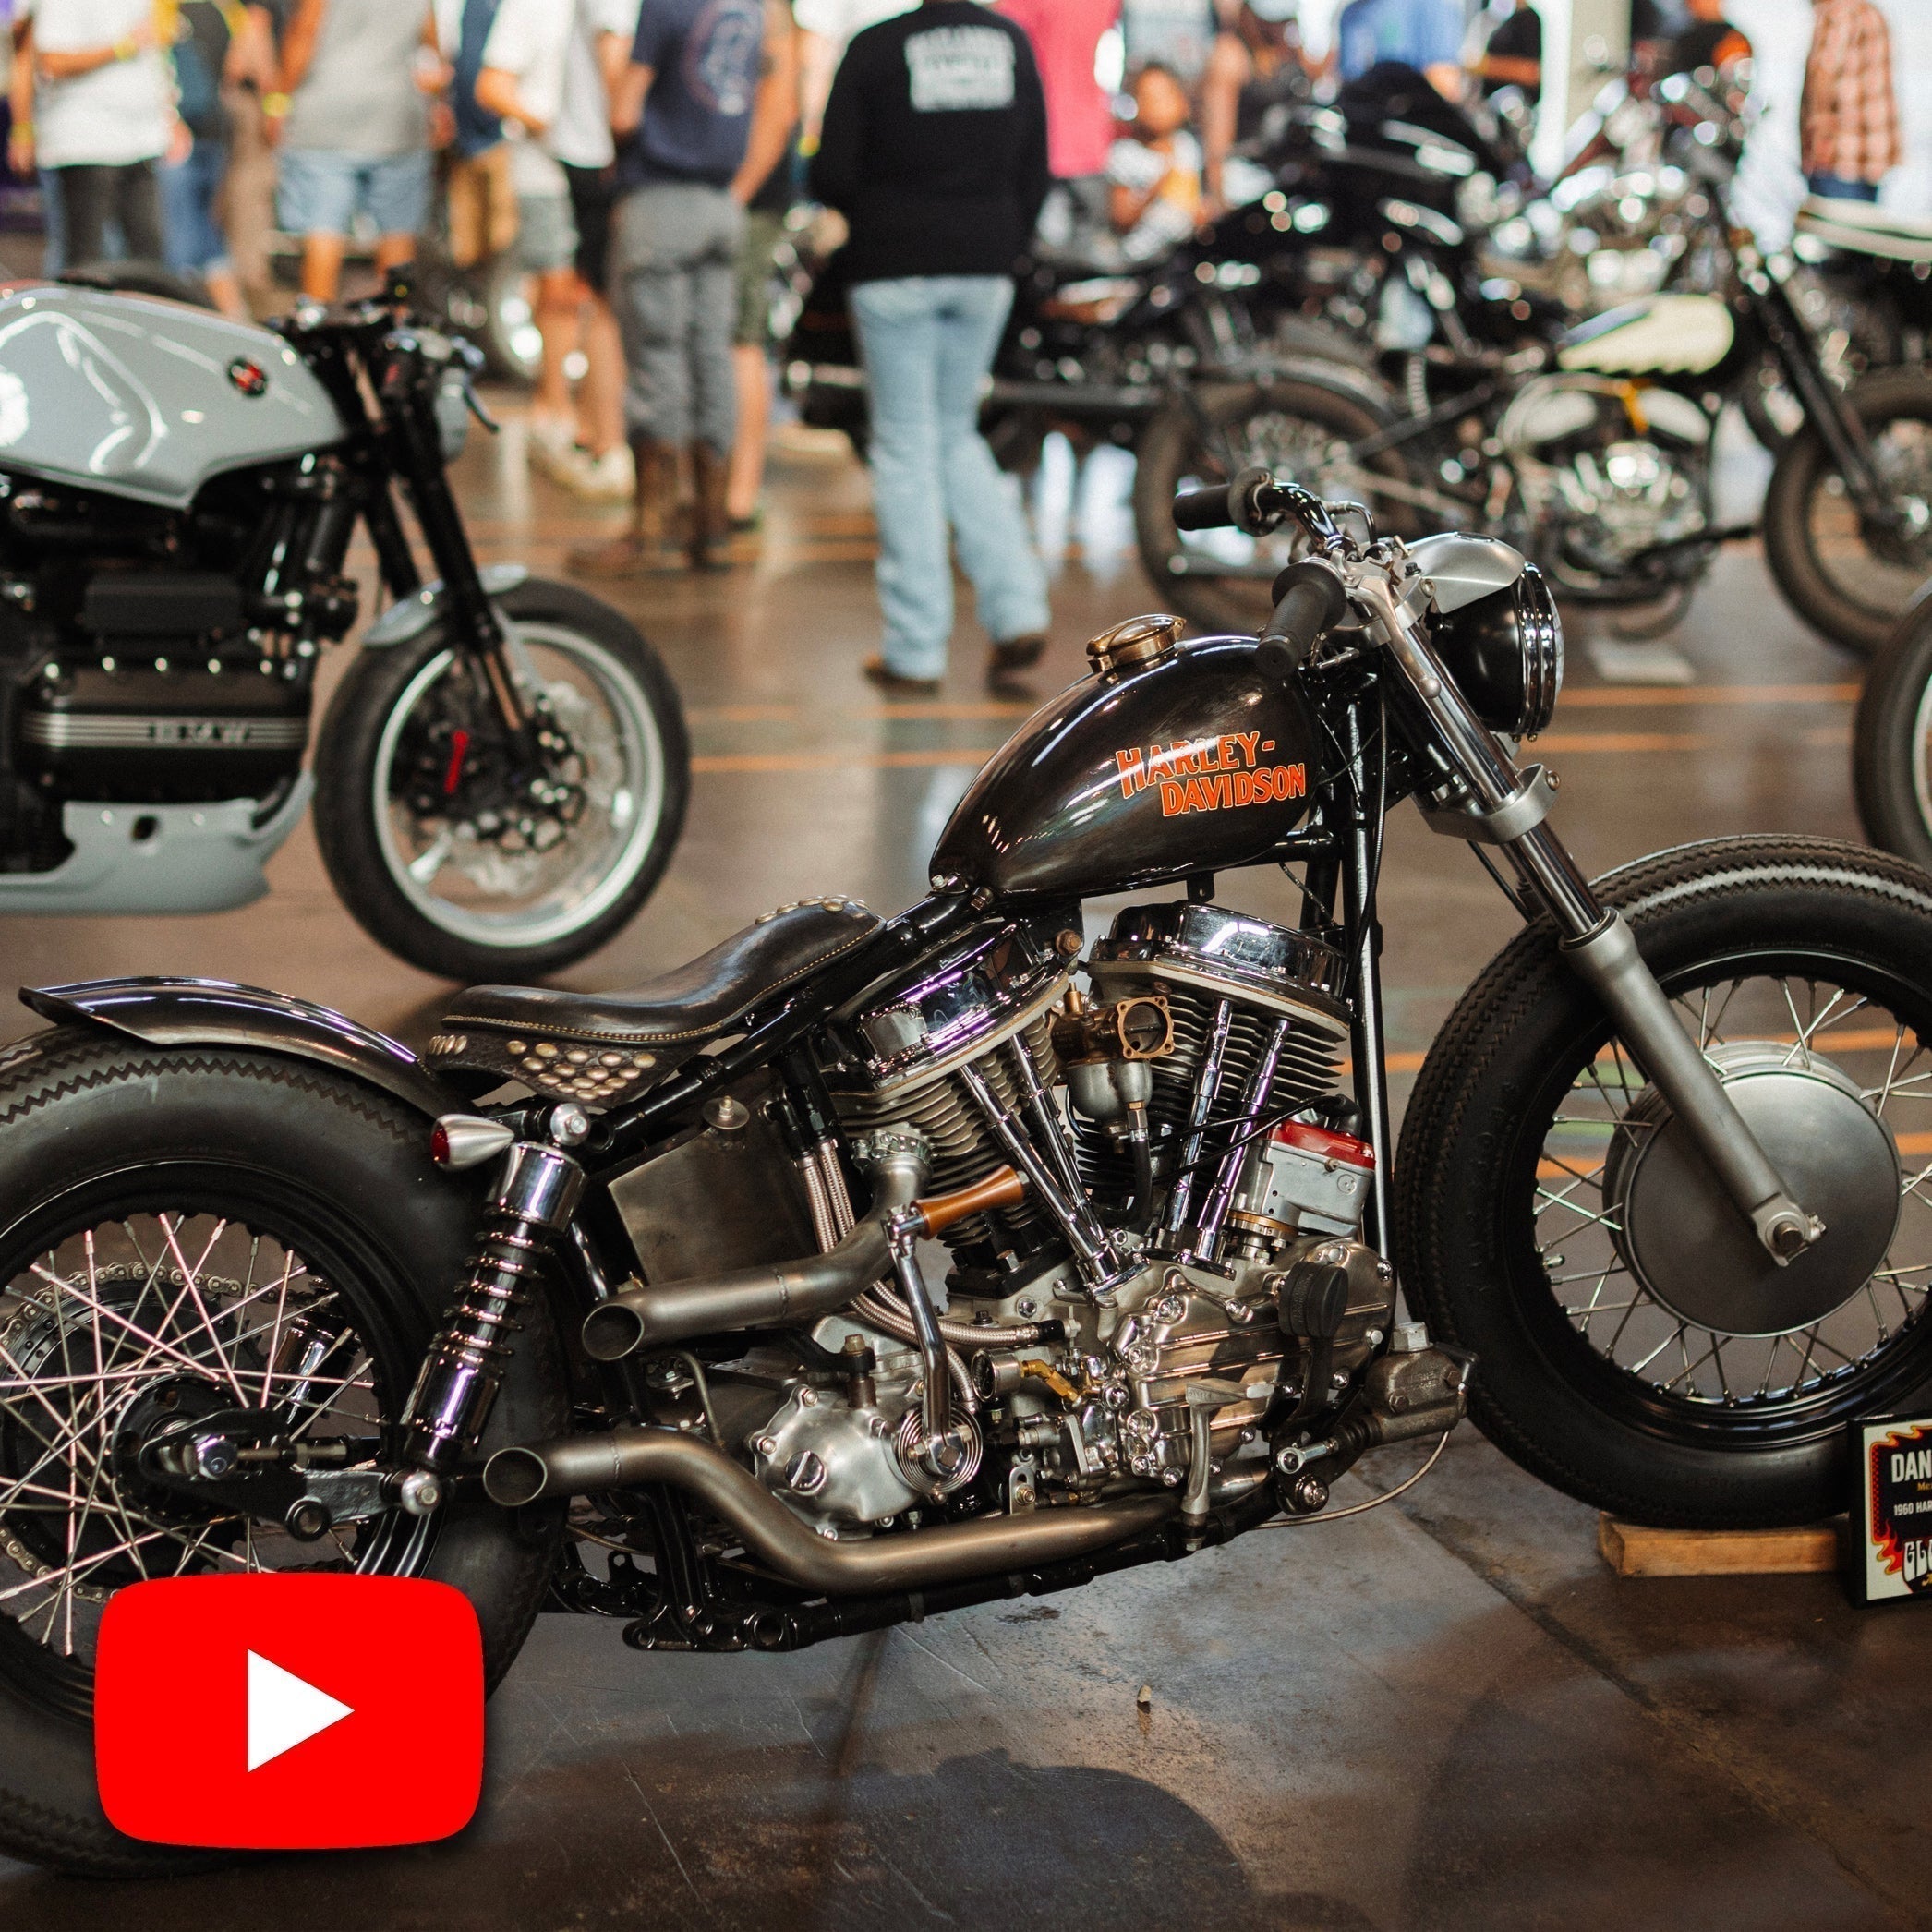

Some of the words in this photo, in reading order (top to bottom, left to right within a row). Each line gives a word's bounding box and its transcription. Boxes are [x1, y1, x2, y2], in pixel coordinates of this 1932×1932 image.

[1116, 731, 1275, 799] HARLEY-
[1160, 763, 1306, 817] DAVIDSON
[1891, 1449, 1932, 1482] DAN
[1894, 1503, 1914, 1515] 1960
